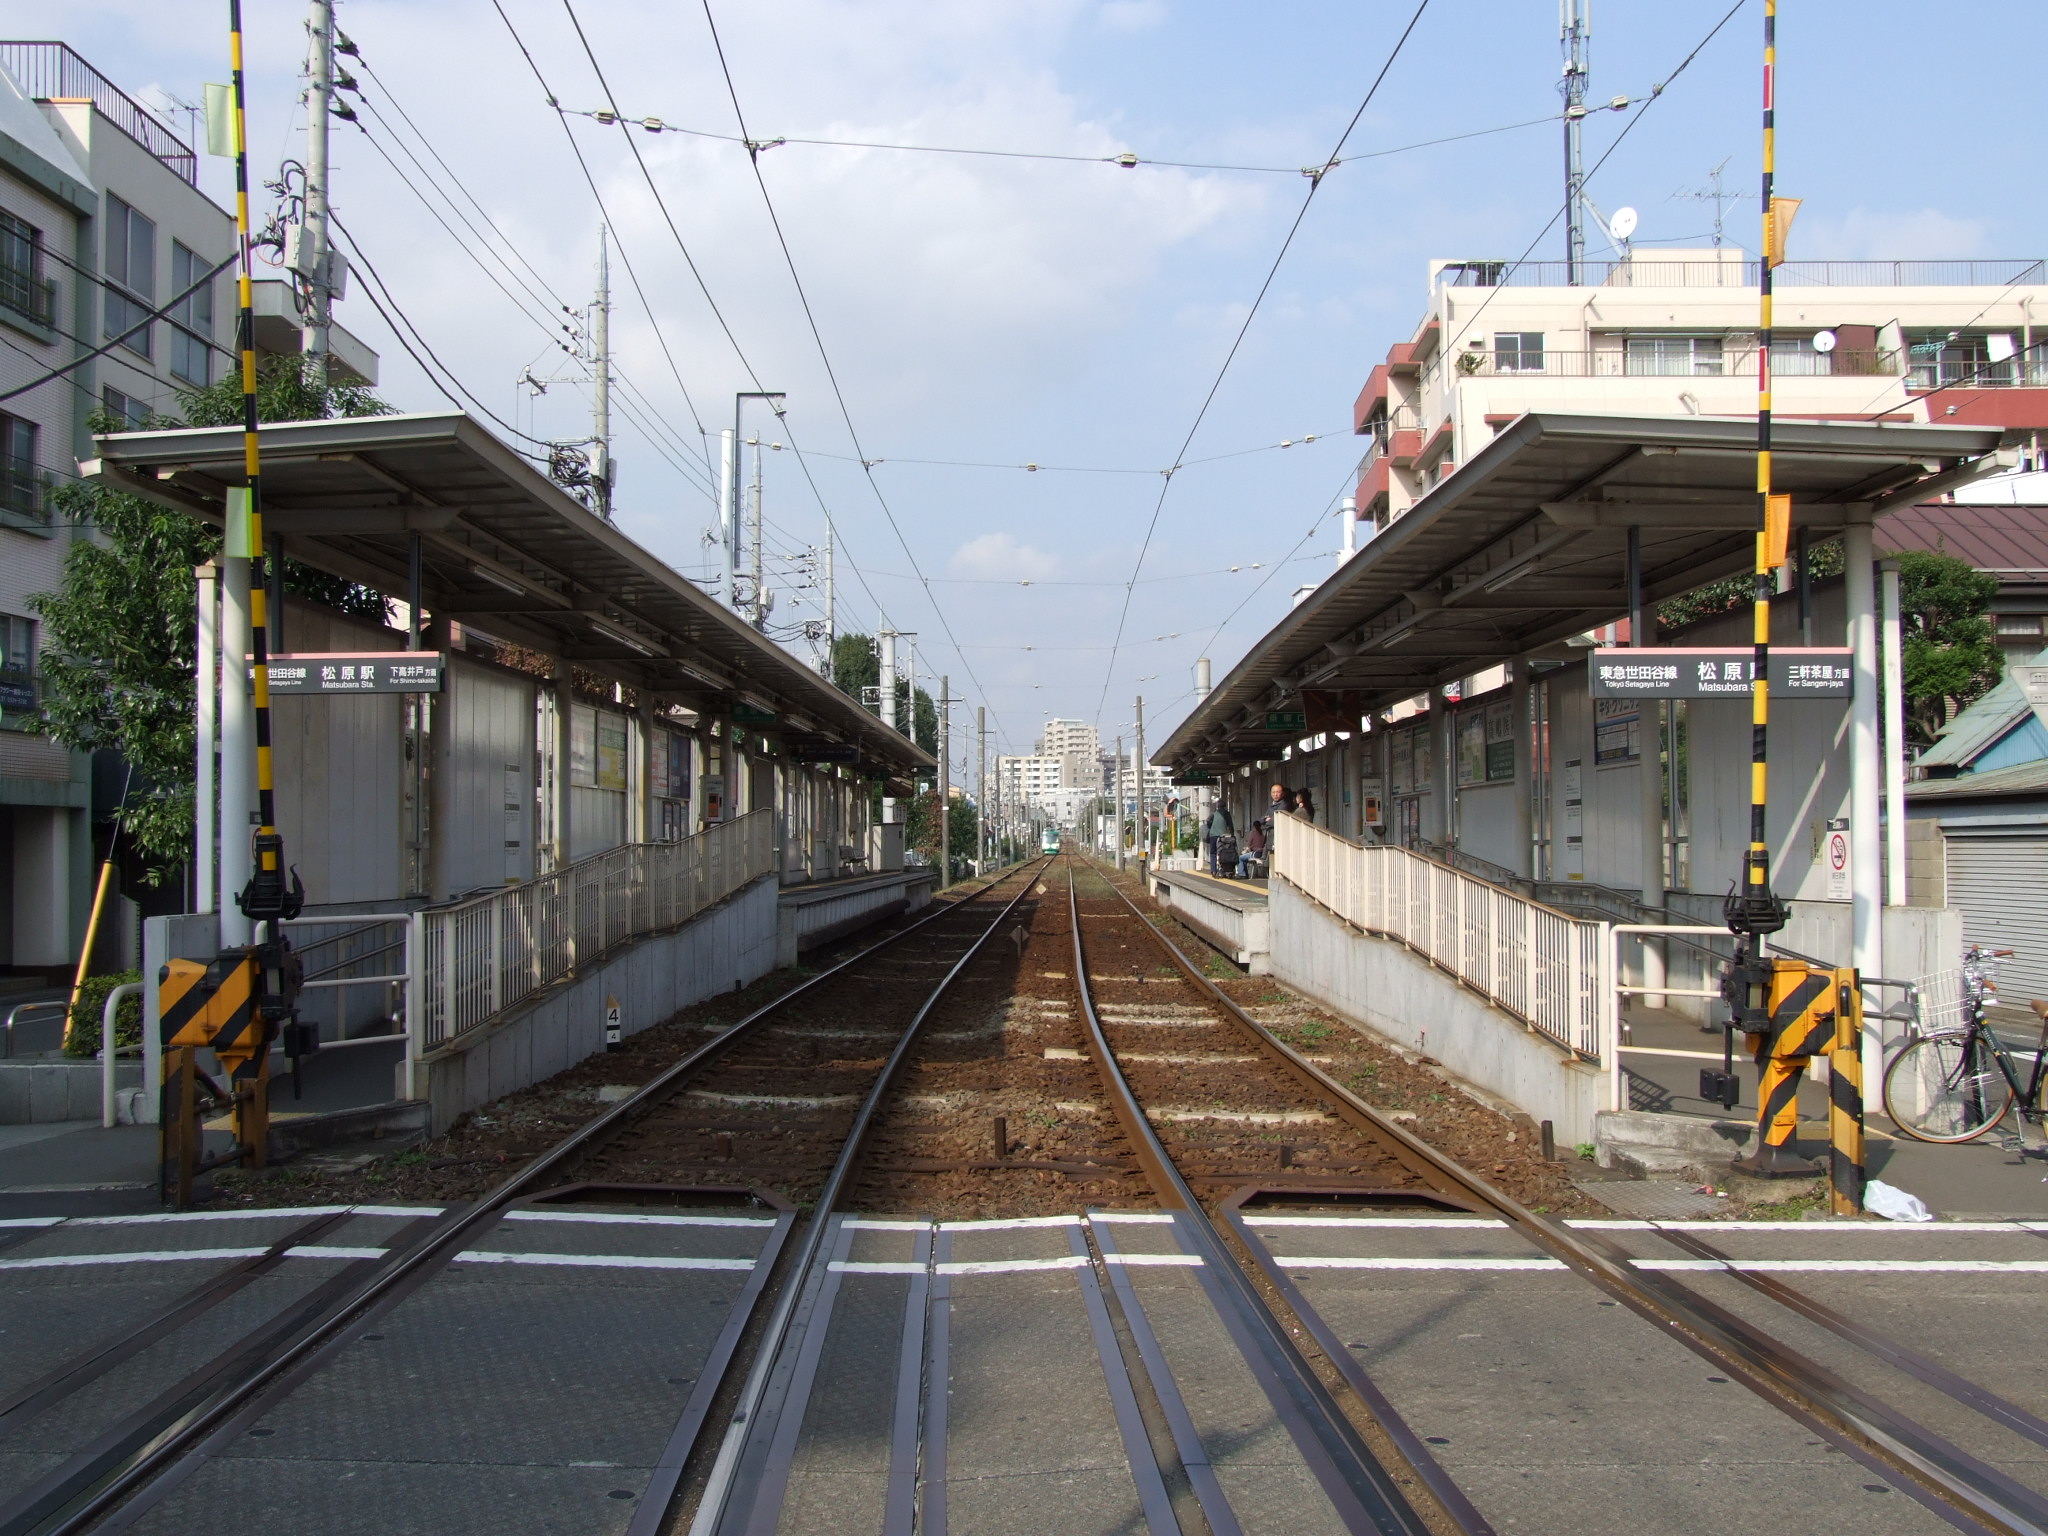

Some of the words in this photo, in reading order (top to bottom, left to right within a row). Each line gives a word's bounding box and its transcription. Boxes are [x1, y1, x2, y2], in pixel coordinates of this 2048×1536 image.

[248, 668, 306, 679] 東世田谷線
[322, 666, 375, 680] 松原駅
[1599, 665, 1678, 680] 東急世田谷線
[322, 681, 360, 689] Matsubara
[1699, 682, 1748, 692] Matsubara
[1801, 680, 1844, 688] Sangen-jaya
[608, 1009, 619, 1022] 4
